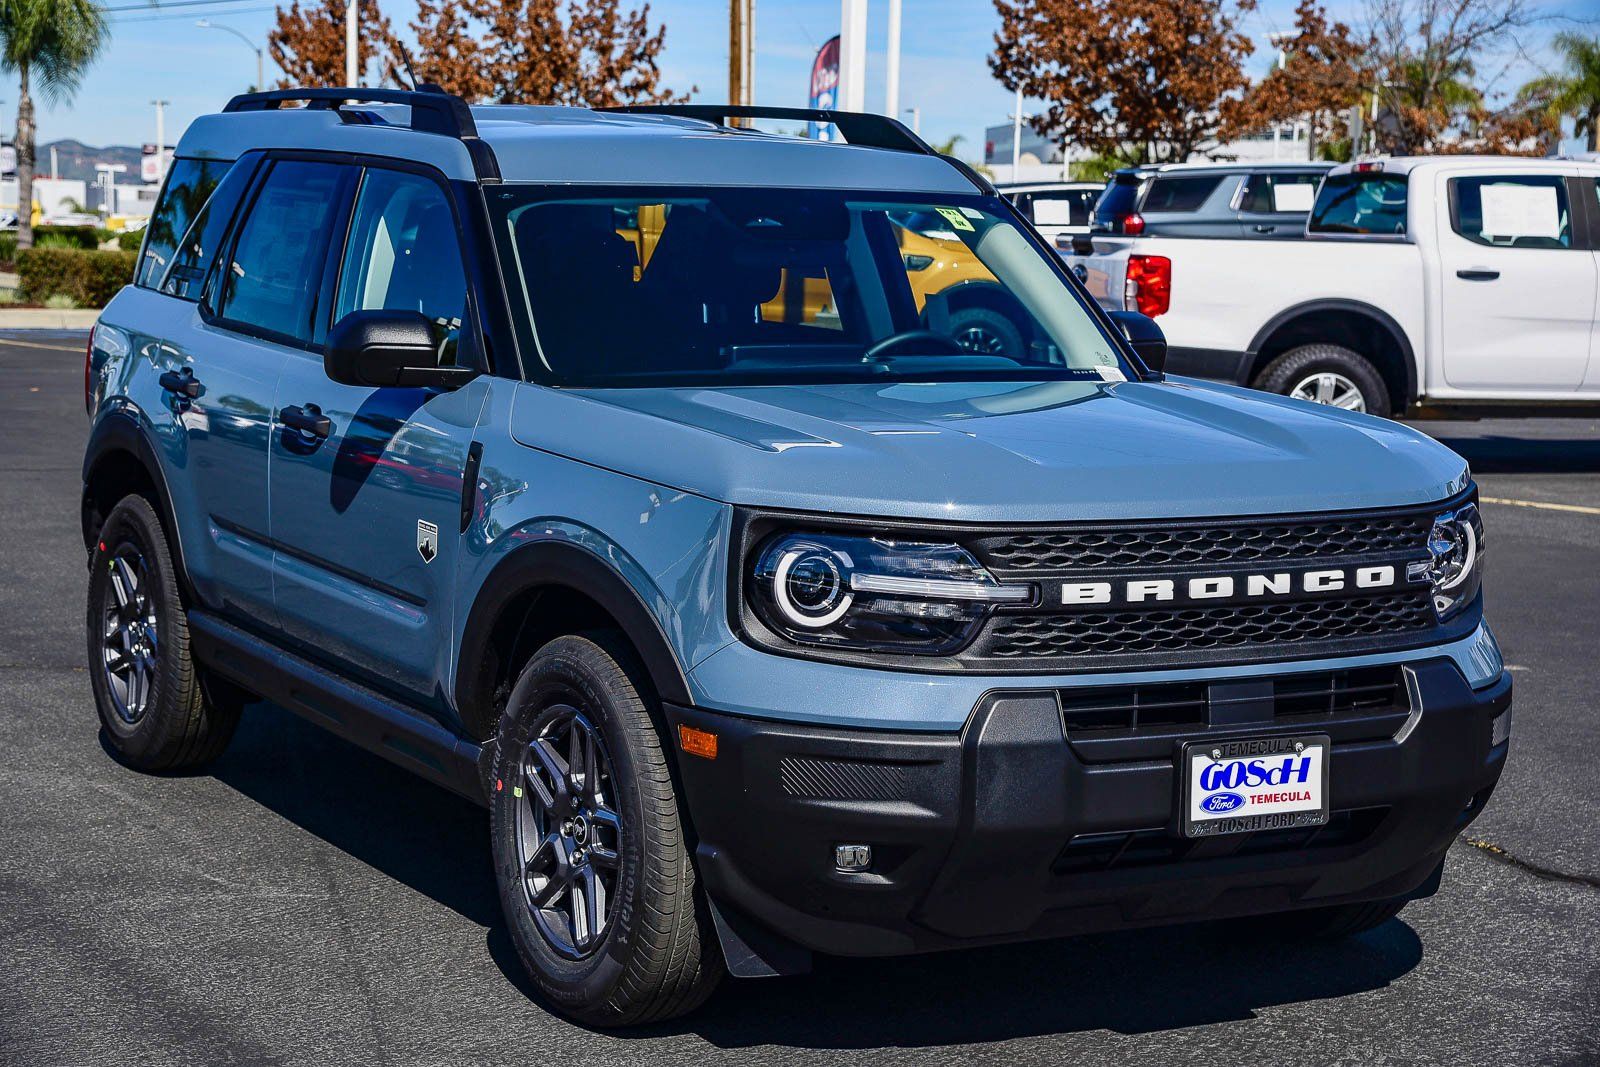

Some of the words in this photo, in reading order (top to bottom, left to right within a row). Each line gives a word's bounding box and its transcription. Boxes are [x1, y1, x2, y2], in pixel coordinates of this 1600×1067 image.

[1061, 565, 1395, 604] BRONCO
[1221, 739, 1294, 755] TEMECULA
[1208, 796, 1235, 811] Ford
[1250, 791, 1311, 805] TEMECULA
[1264, 813, 1295, 828] FORD
